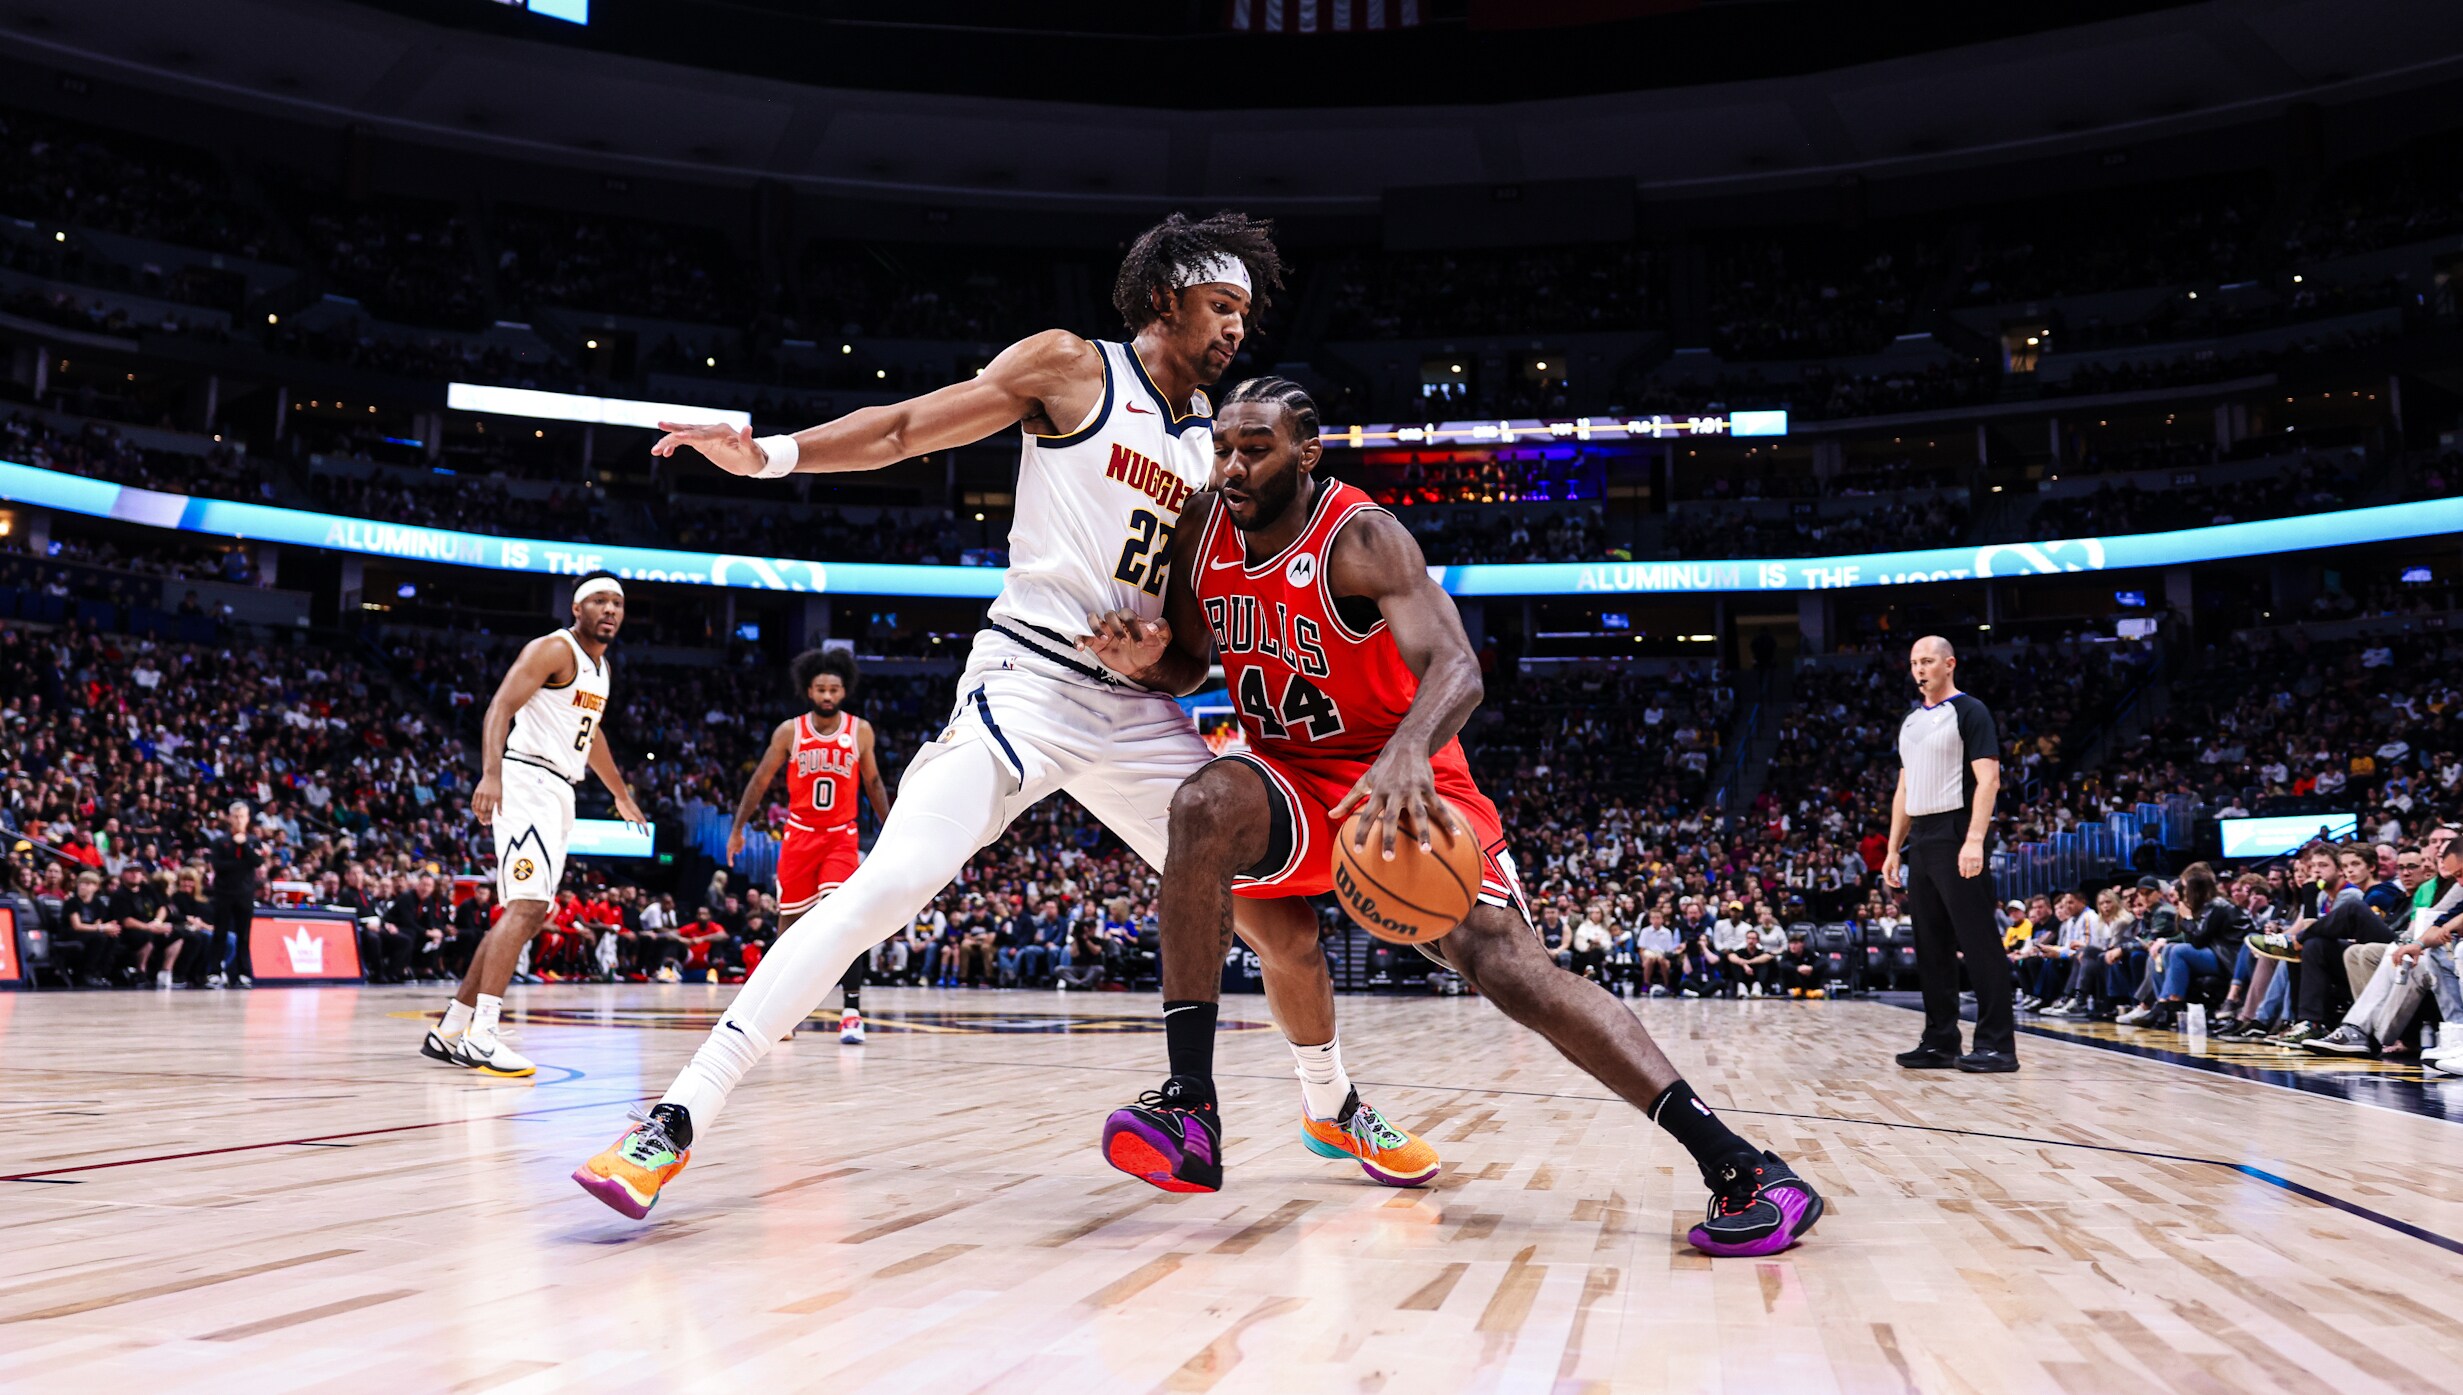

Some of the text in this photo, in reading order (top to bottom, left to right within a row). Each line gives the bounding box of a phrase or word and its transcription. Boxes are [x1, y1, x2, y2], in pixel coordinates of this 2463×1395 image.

[325, 521, 603, 575] ALUMINUM IS THE
[1112, 508, 1176, 598] 22
[1577, 564, 1740, 590] ALUMINUM
[1759, 563, 1787, 588] IS
[1203, 594, 1330, 679] BULLS
[1238, 665, 1345, 742] 44
[574, 716, 593, 752] 2
[798, 748, 855, 778] BULLS
[812, 777, 836, 811] 0
[1336, 860, 1420, 936] Wilson
